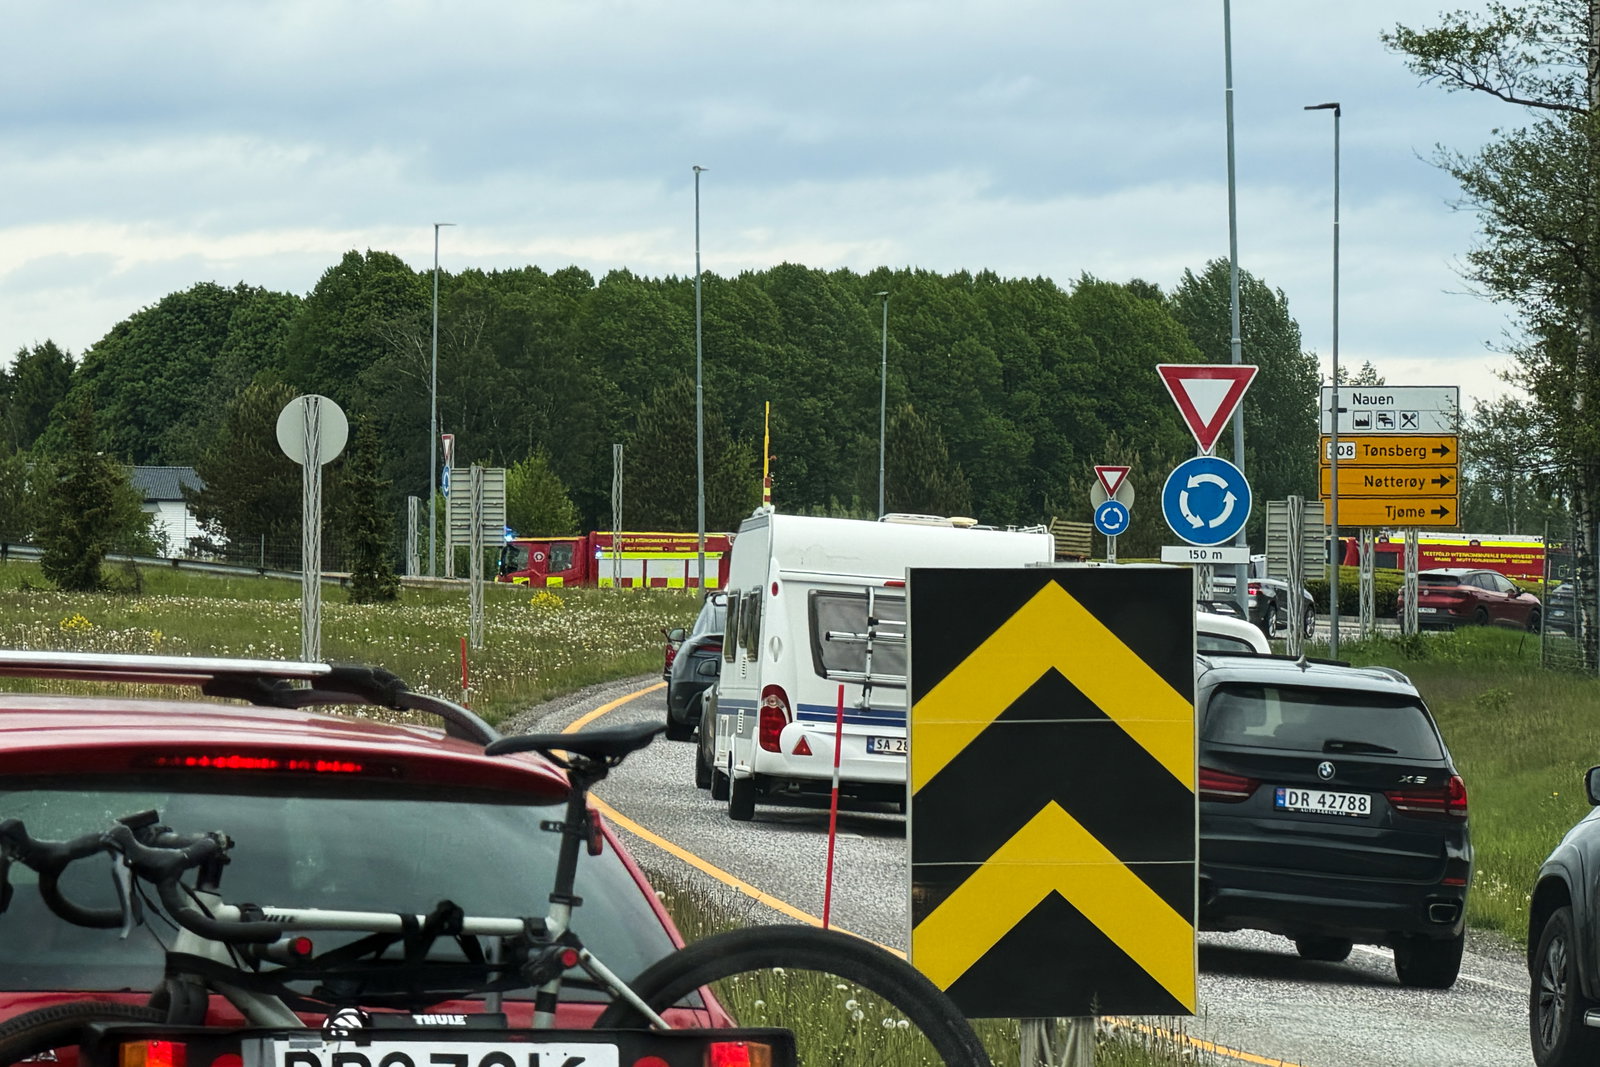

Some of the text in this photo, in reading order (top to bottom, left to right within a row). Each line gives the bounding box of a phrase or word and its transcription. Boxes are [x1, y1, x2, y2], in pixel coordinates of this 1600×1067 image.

[1352, 392, 1394, 405] Nauen
[1362, 444, 1427, 459] Tønsberg
[1364, 475, 1426, 490] Nøtterøy
[1385, 505, 1426, 520] Tjøme
[1189, 549, 1223, 559] 150 m
[876, 739, 891, 750] SA
[1288, 791, 1367, 812] DR 42788
[412, 1013, 466, 1026] THULE
